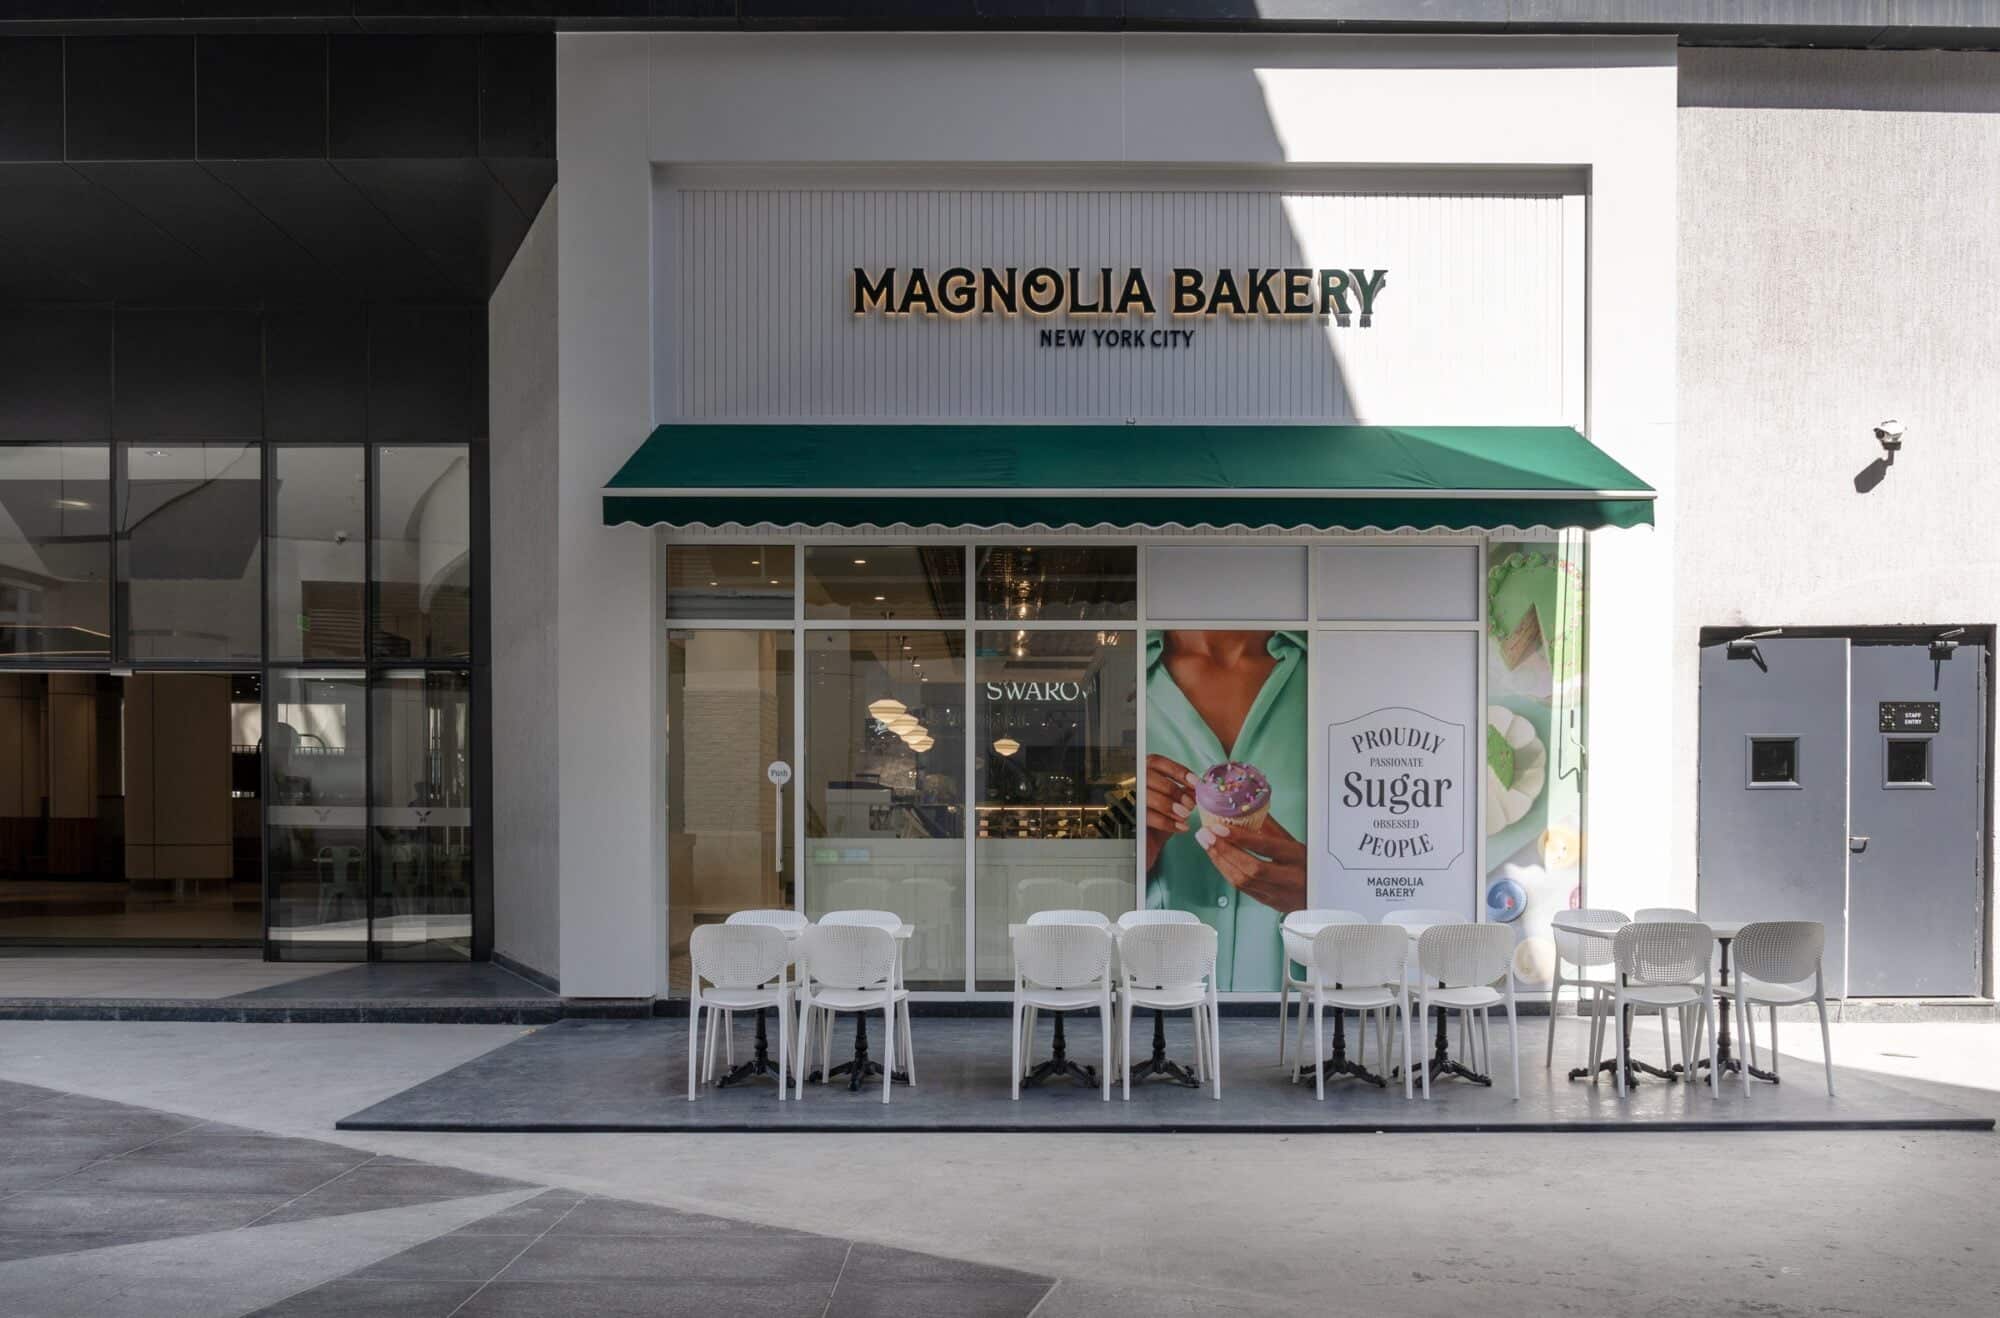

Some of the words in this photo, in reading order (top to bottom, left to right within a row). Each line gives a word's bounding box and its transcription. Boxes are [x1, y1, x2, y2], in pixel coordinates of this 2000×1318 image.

[854, 267, 1156, 315] MAGNOLIA
[1173, 267, 1389, 315] BAKERY
[1040, 329, 1086, 348] NEW
[1092, 329, 1145, 348] YORK
[1150, 329, 1195, 348] CITY
[1351, 727, 1446, 754] PROUDLY
[1369, 757, 1424, 768] PASSIONATE
[1342, 771, 1453, 815] Sugar
[1373, 819, 1420, 830] OBSESSED
[1358, 832, 1435, 858] PEOPLE
[1367, 877, 1424, 887] MAGNOLIA
[1375, 887, 1416, 897] BAKERY
